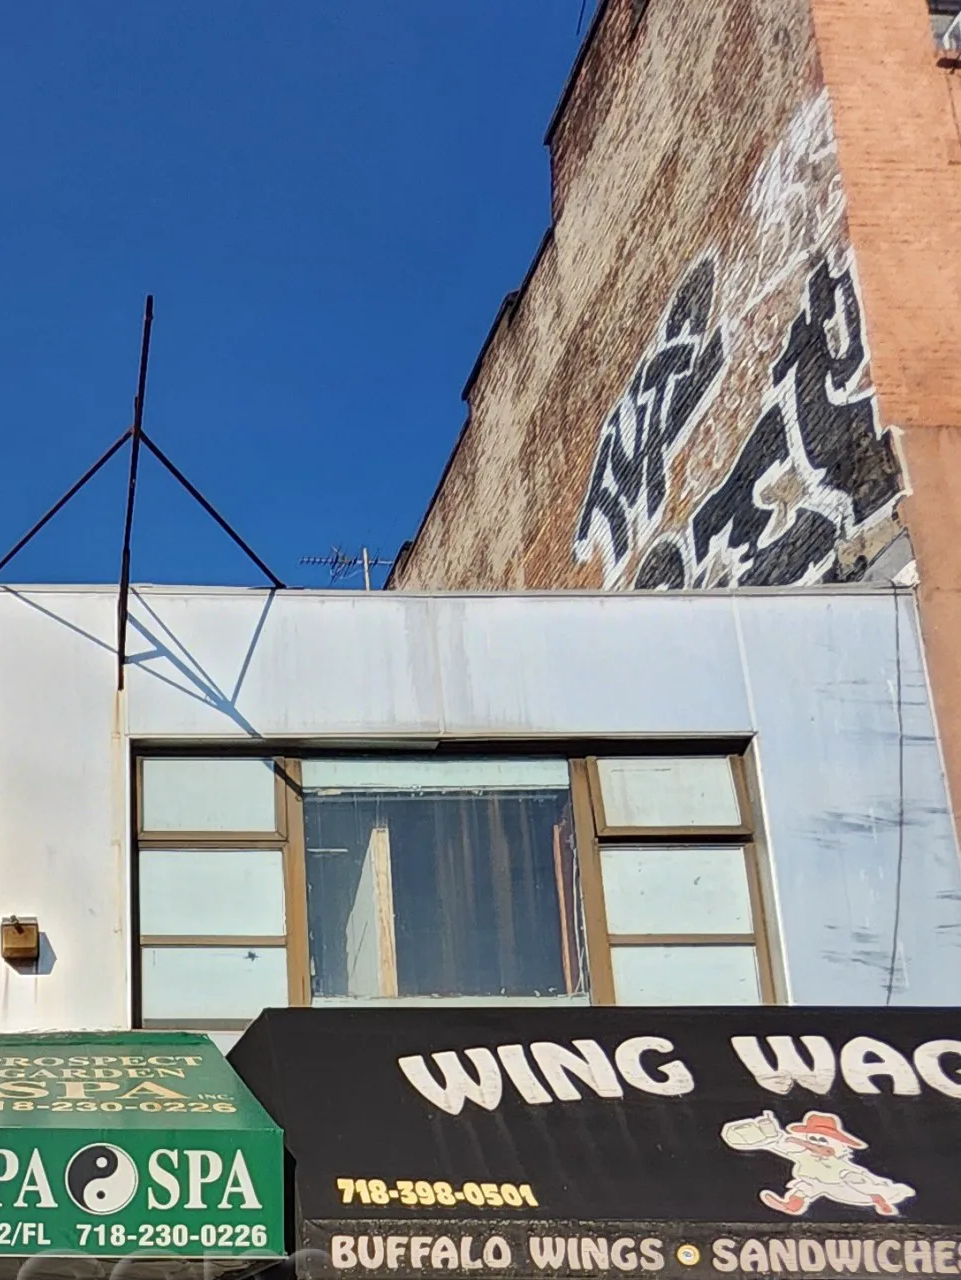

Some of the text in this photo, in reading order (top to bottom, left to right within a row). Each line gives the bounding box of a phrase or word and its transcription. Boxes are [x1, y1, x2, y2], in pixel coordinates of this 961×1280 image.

[398, 1036, 695, 1116] WING
[148, 1148, 262, 1210] SPA
[337, 1178, 539, 1207] 718-398-0501
[76, 1224, 267, 1247] 718-230-0226
[331, 1235, 665, 1272] BUFFALO WINGS
[711, 1236, 961, 1273] SANDWICHE
